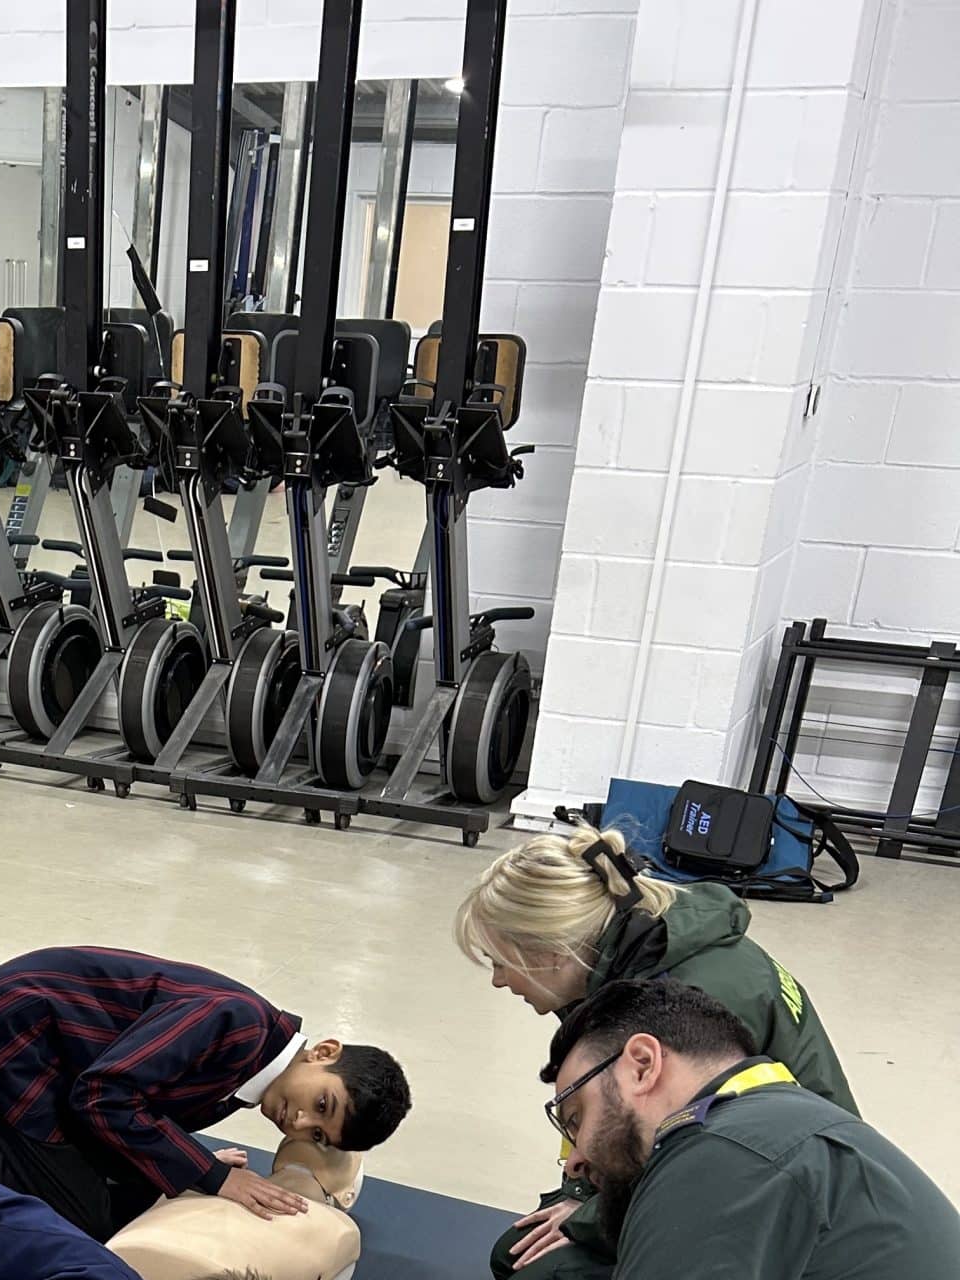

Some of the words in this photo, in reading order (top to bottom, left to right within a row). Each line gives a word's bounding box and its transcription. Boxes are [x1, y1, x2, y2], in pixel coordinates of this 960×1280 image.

[89, 65, 98, 129] Concept
[685, 802, 701, 836] Trainer
[697, 811, 711, 834] AED
